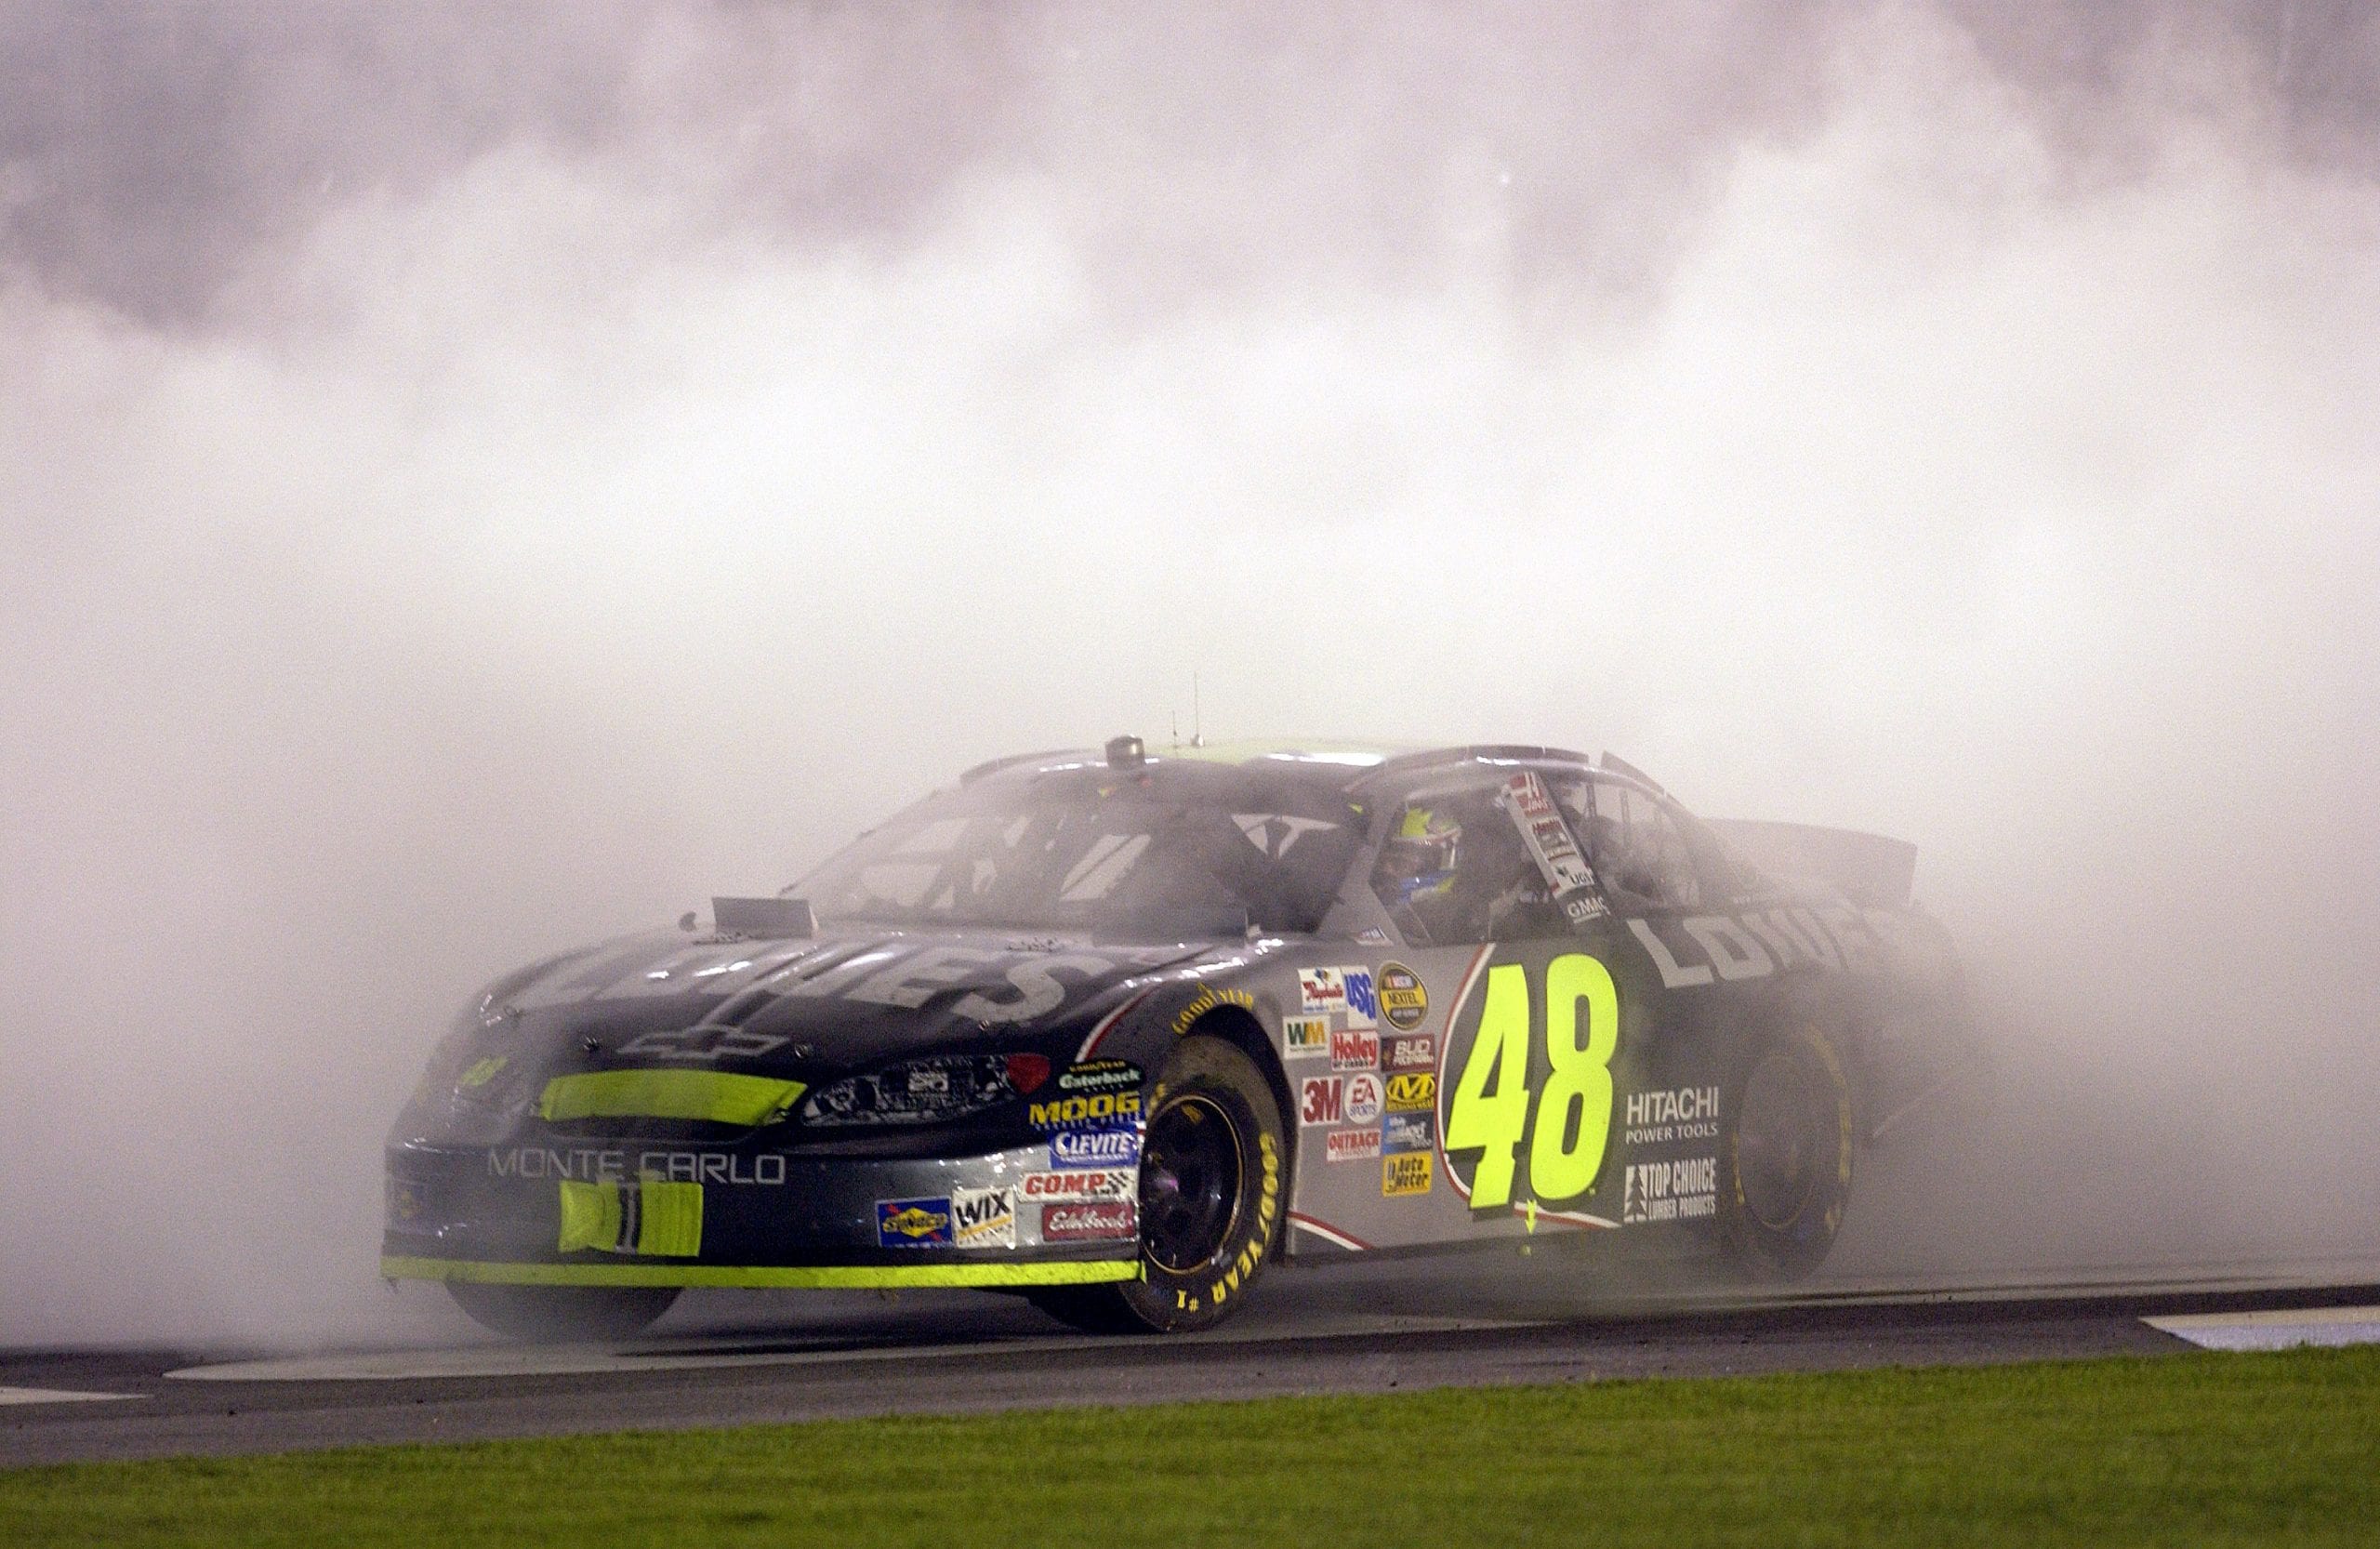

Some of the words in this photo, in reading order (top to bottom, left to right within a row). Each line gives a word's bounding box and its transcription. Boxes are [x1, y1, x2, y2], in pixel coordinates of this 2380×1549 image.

[1344, 973, 1376, 1020] USG
[1287, 1021, 1326, 1045] WM
[1331, 1032, 1378, 1066] Holley
[1395, 1039, 1432, 1055] BUD
[1352, 1079, 1376, 1104] EA
[1445, 952, 1619, 1210] 48
[1029, 1092, 1140, 1125] MOOG
[1303, 1079, 1342, 1123] 3M
[1627, 1086, 1719, 1126] HITACHI
[1055, 1131, 1132, 1156] CLEVITE
[1626, 1127, 1673, 1145] POWER
[1676, 1121, 1719, 1141] TOOLS
[487, 1148, 623, 1180] MONTE
[639, 1152, 786, 1185] CARLO
[1648, 1161, 1672, 1198] TOP
[1673, 1157, 1717, 1196] CHOICE
[1025, 1172, 1106, 1196] COMP
[956, 1194, 1011, 1227] WIX
[1648, 1197, 1677, 1220] LUMBER
[1679, 1192, 1716, 1219] PRODUCTS
